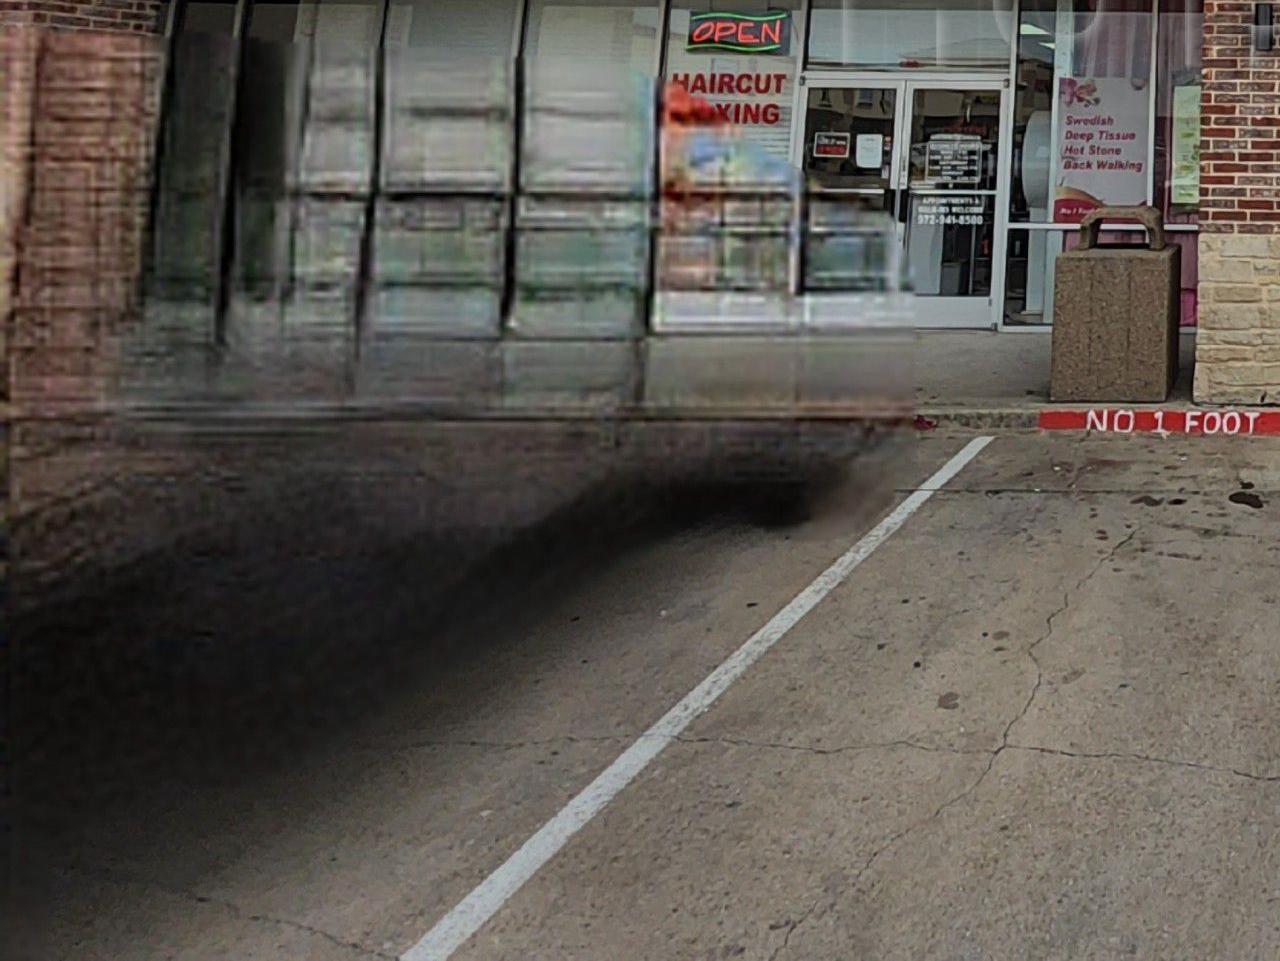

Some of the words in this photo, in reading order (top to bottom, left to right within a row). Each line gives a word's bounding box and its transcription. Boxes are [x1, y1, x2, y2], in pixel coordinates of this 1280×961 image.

[692, 19, 781, 44] OPEN
[672, 73, 787, 94] HAIRCUT
[1065, 115, 1115, 126] Swedish
[1064, 130, 1095, 142] Deep
[1099, 130, 1137, 141] Tissue
[1063, 145, 1085, 156] Hot
[1089, 145, 1122, 156] Stone
[1063, 160, 1093, 170] Back
[1096, 160, 1144, 173] Walking
[1085, 410, 1136, 433] NO
[1153, 411, 1165, 433] 1
[1184, 411, 1261, 435] FOOT
